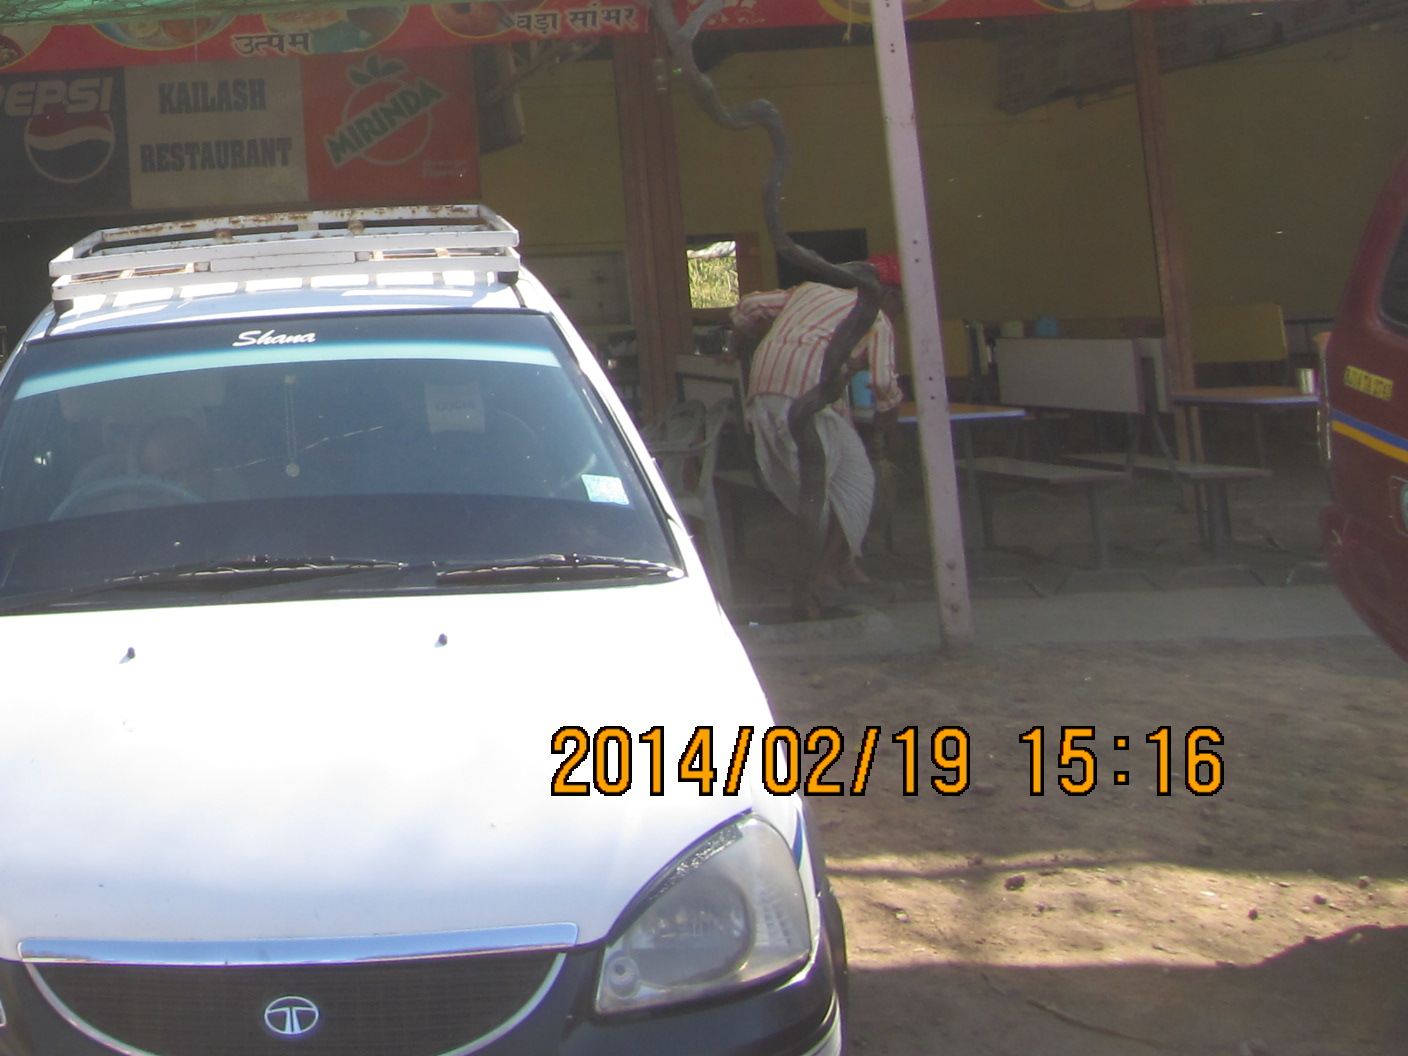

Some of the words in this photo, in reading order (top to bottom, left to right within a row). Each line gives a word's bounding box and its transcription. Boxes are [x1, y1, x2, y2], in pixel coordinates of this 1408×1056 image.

[568, 2, 637, 29] सांभर
[158, 79, 266, 114] KAILASH
[325, 81, 443, 165] MIRINDA
[140, 137, 292, 173] RESTAURANT
